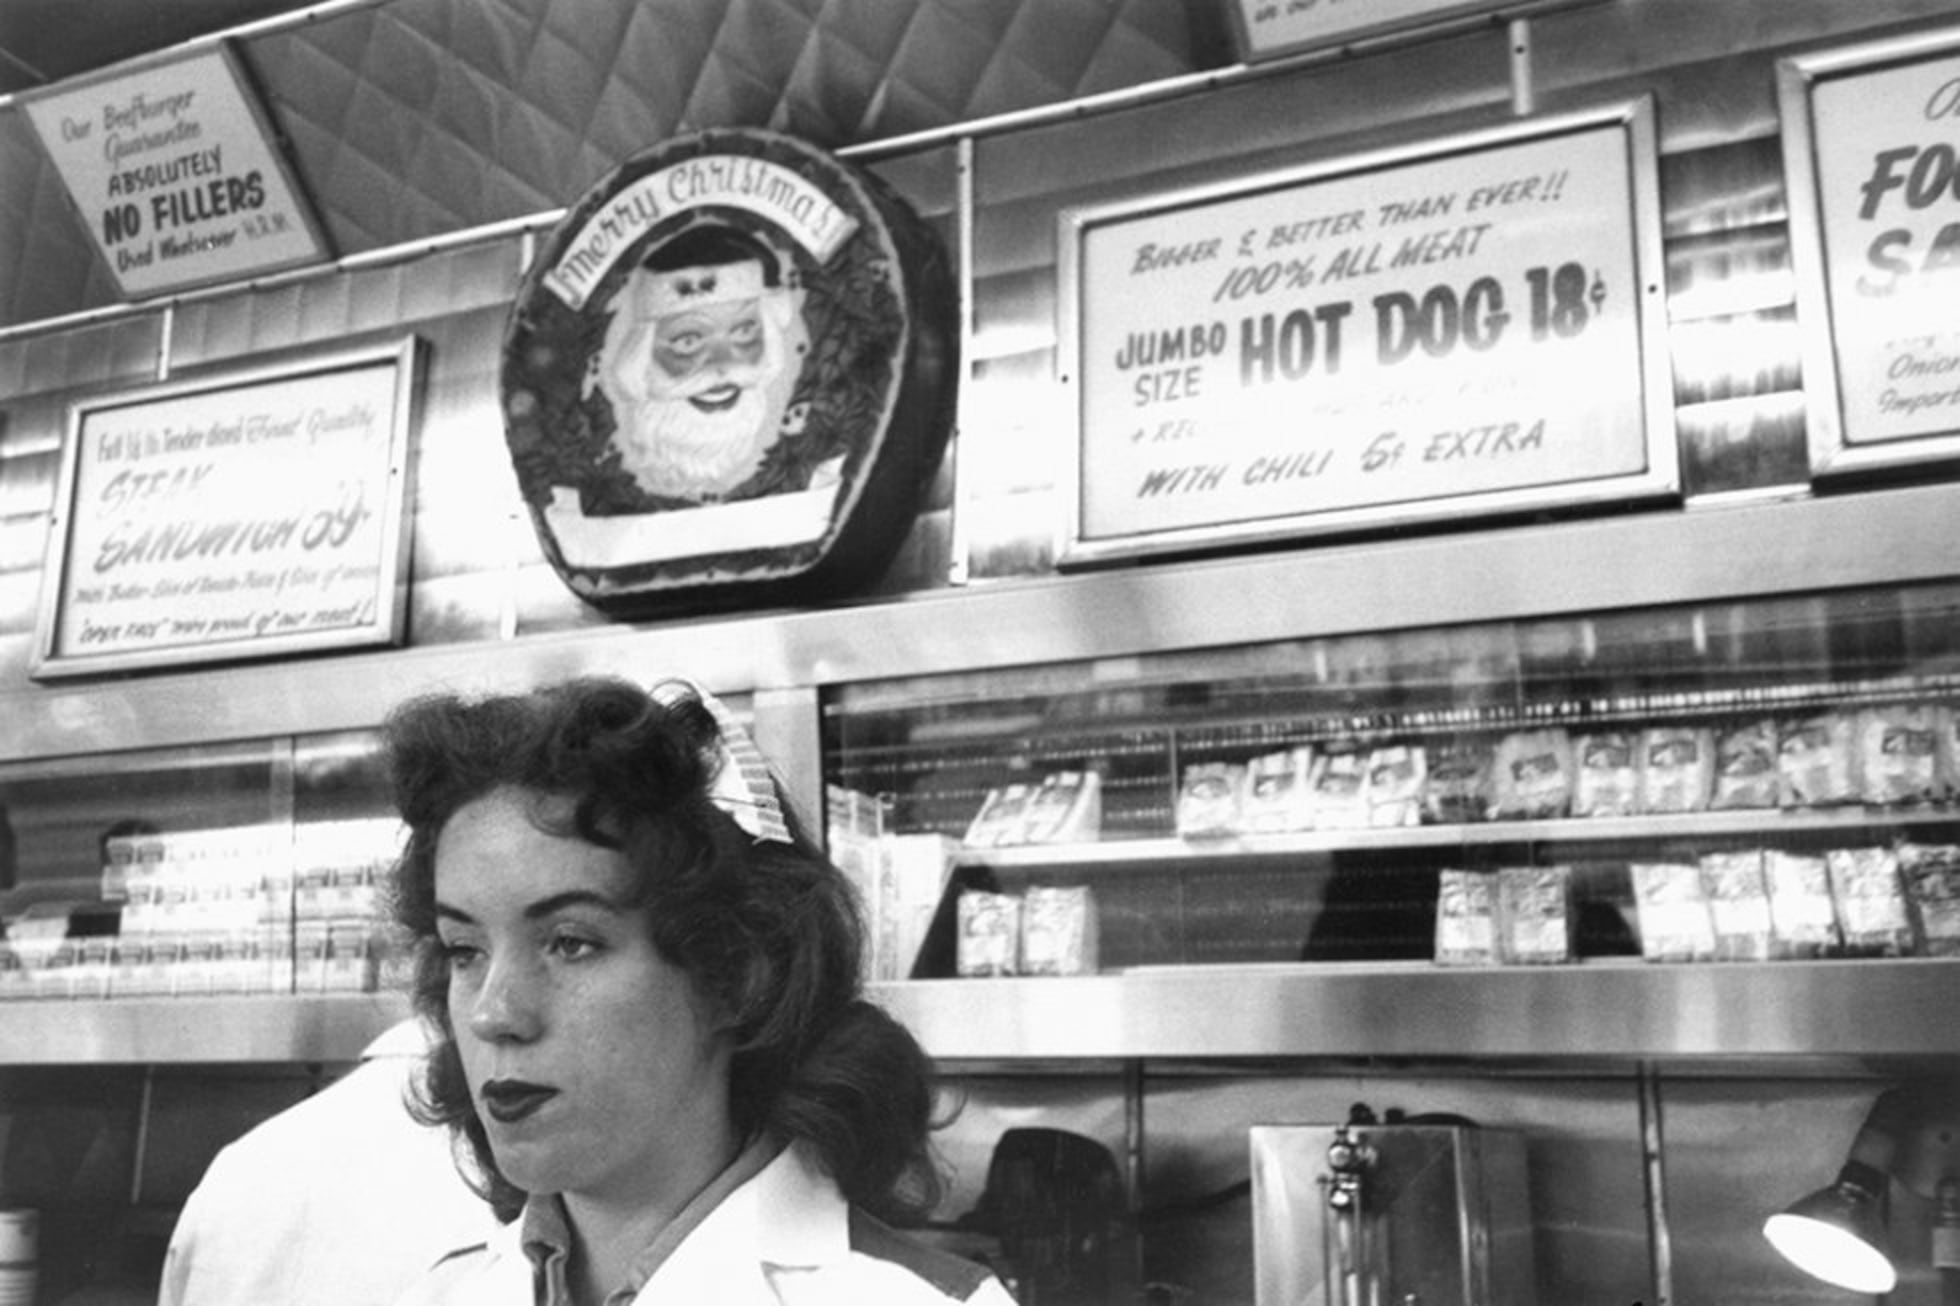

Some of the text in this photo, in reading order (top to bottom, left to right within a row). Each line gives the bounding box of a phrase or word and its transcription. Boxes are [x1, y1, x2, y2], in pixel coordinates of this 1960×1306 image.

[61, 116, 92, 142] Our
[103, 169, 266, 246] NO FILLERS
[109, 144, 222, 197] ABSOLUTELY
[667, 155, 832, 238] Christmas
[1858, 142, 1960, 220] FO
[1130, 237, 1222, 276] BIGGER
[1266, 209, 1364, 249] BETTER
[1378, 192, 1456, 227] THAN
[1466, 169, 1568, 212] EVER!!
[1213, 223, 1492, 303] 100% ALL MEAT
[1115, 321, 1227, 371] JUMBO
[1240, 301, 1353, 388] HOT
[1372, 275, 1511, 366] DOG
[1134, 365, 1202, 407] SIZE
[1137, 464, 1228, 498] WITH
[1242, 449, 1333, 485] CHILI
[1423, 418, 1546, 461] EXTRA
